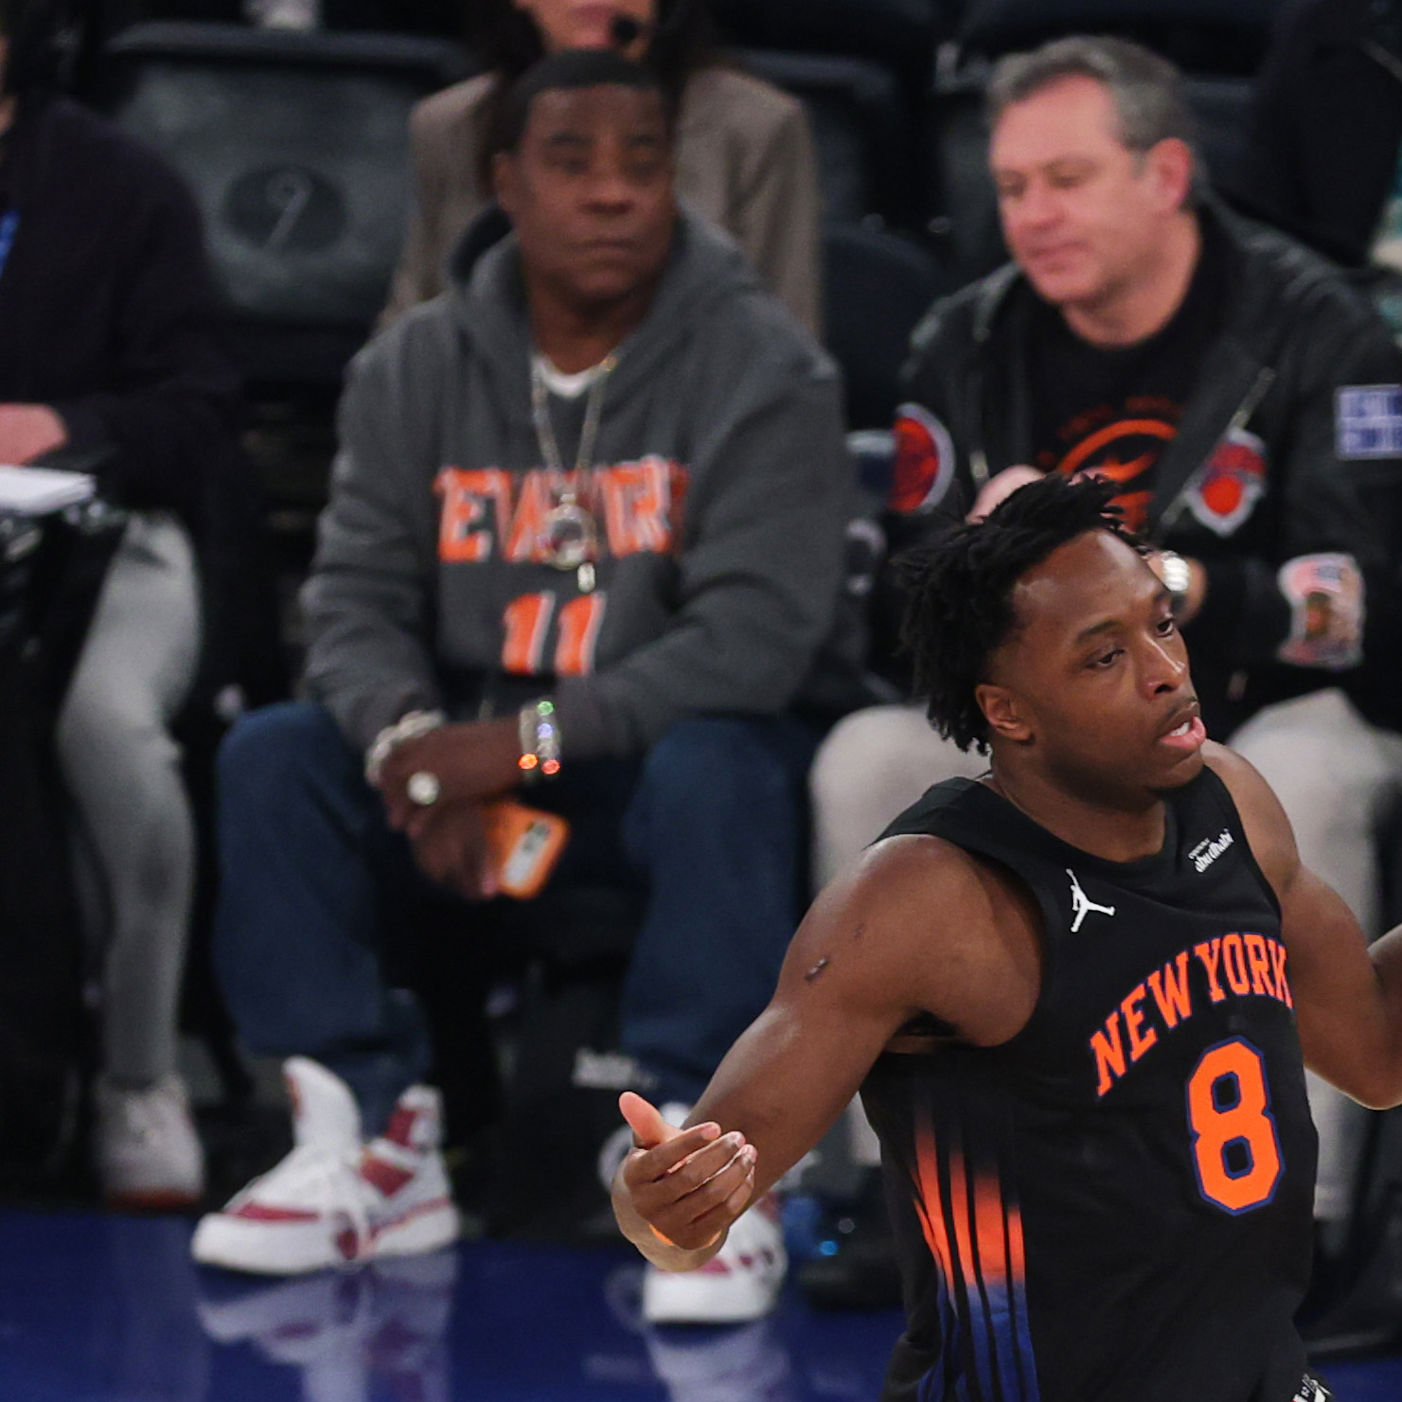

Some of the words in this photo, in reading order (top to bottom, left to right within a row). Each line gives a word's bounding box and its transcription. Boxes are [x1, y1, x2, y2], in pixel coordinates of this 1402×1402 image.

[502, 591, 606, 677] 11
[1088, 950, 1193, 1098] NEW
[1193, 932, 1294, 1011] YORK
[1186, 1034, 1285, 1216] 8
